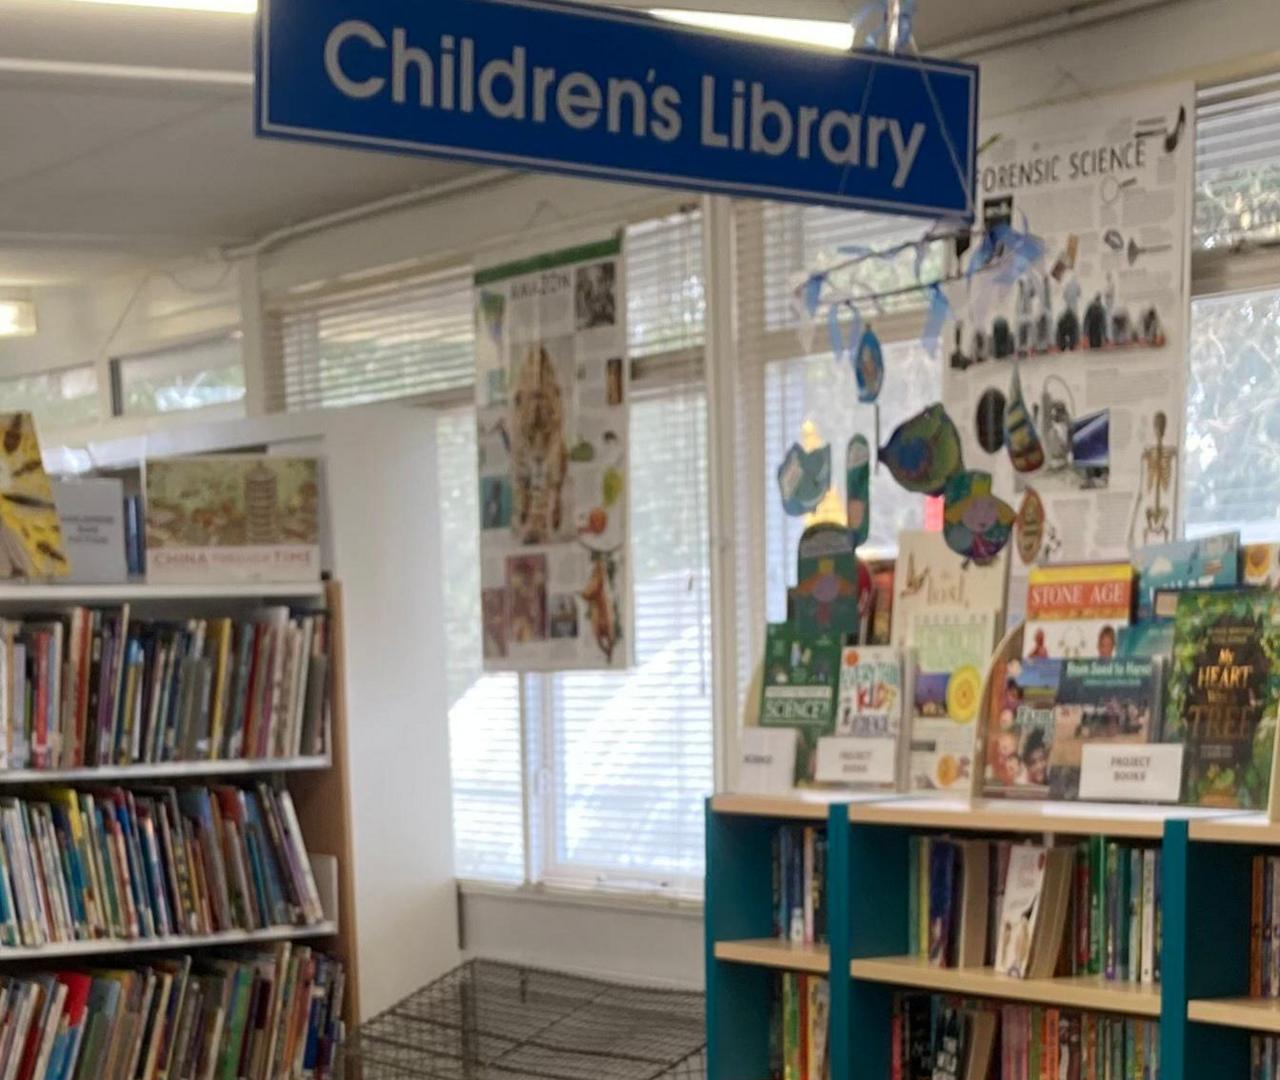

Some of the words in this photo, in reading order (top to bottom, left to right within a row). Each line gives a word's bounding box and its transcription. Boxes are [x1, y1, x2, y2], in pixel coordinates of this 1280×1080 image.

[322, 18, 684, 144] Children's
[700, 74, 927, 190] Library
[977, 151, 1061, 193] ORENSIC
[1068, 138, 1147, 181] SCIENCE
[1030, 584, 1083, 606] STONE
[1089, 582, 1125, 604] AGE
[1197, 664, 1254, 689] HEART
[1110, 756, 1152, 768] PROJECT
